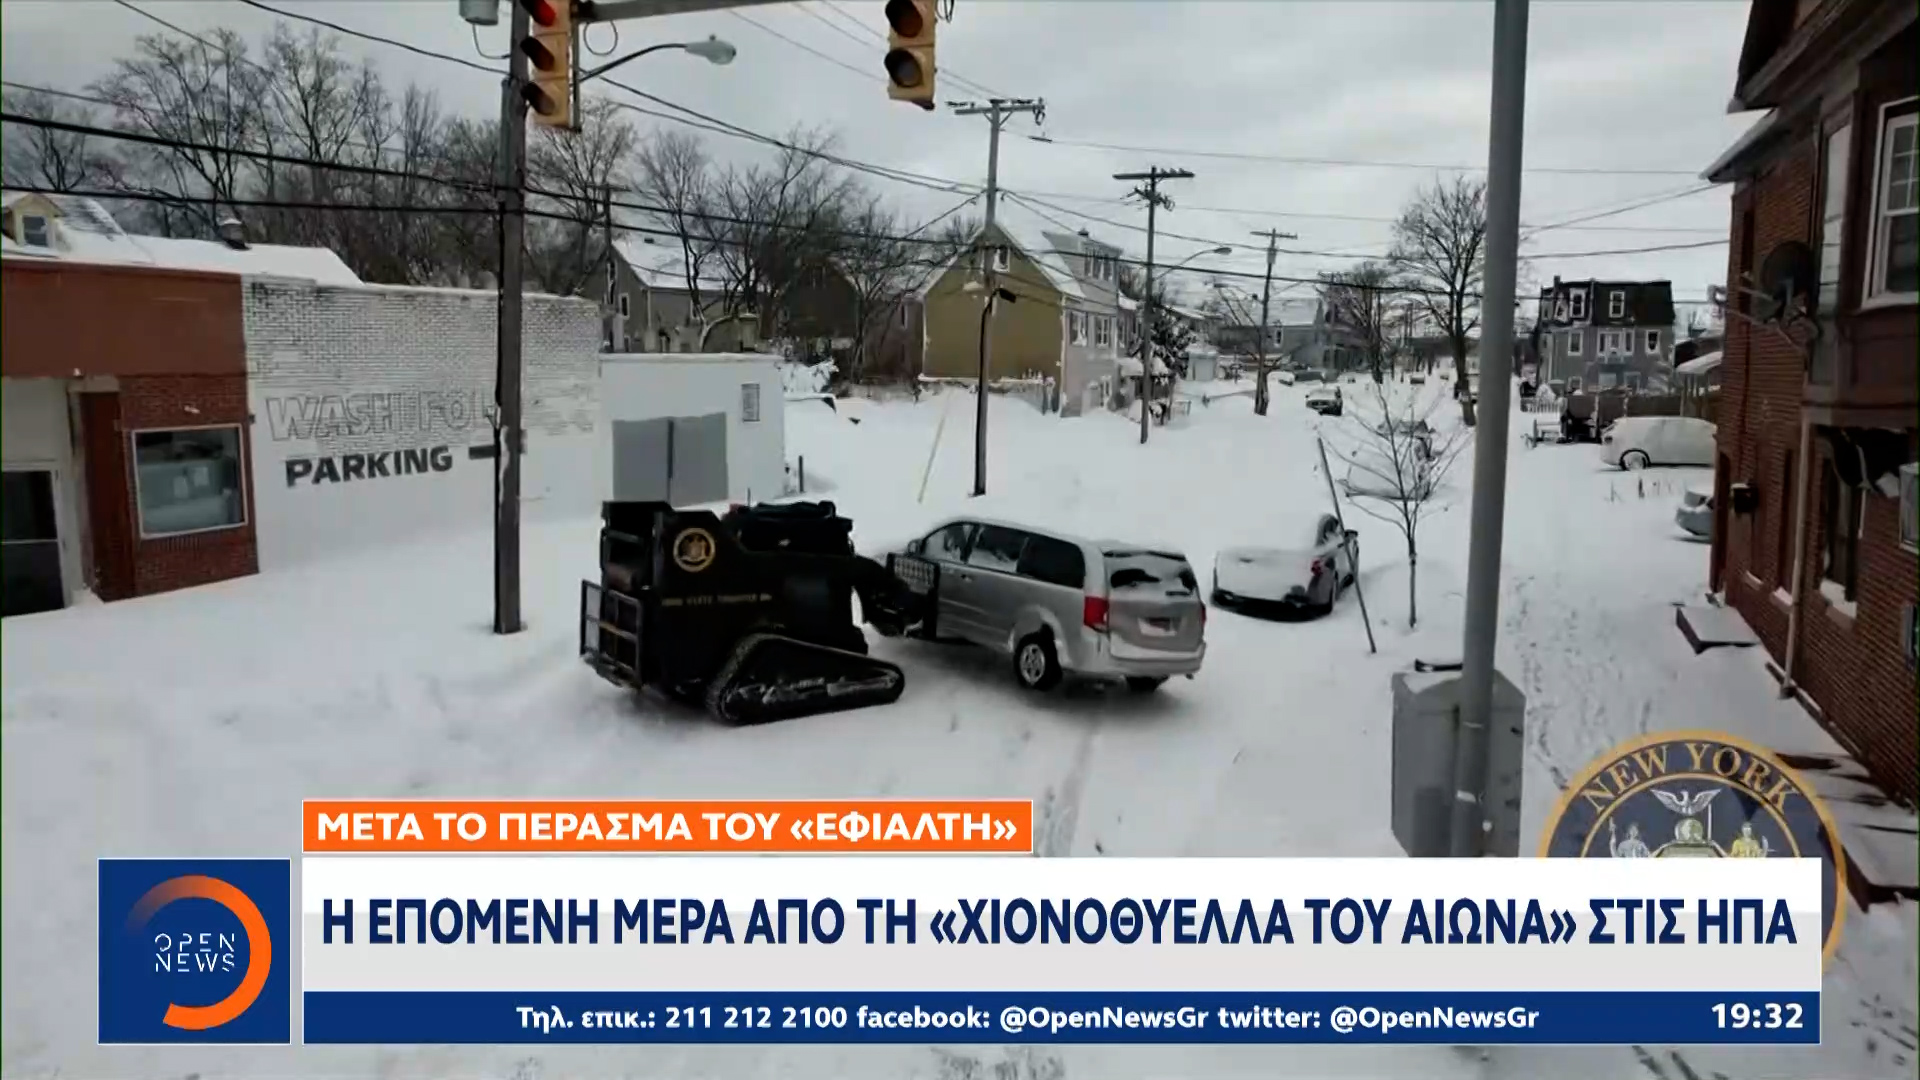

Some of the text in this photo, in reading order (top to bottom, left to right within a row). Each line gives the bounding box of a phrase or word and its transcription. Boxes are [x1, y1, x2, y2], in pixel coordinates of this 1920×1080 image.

[265, 389, 496, 441] WASH FOL
[285, 445, 453, 488] PARKING
